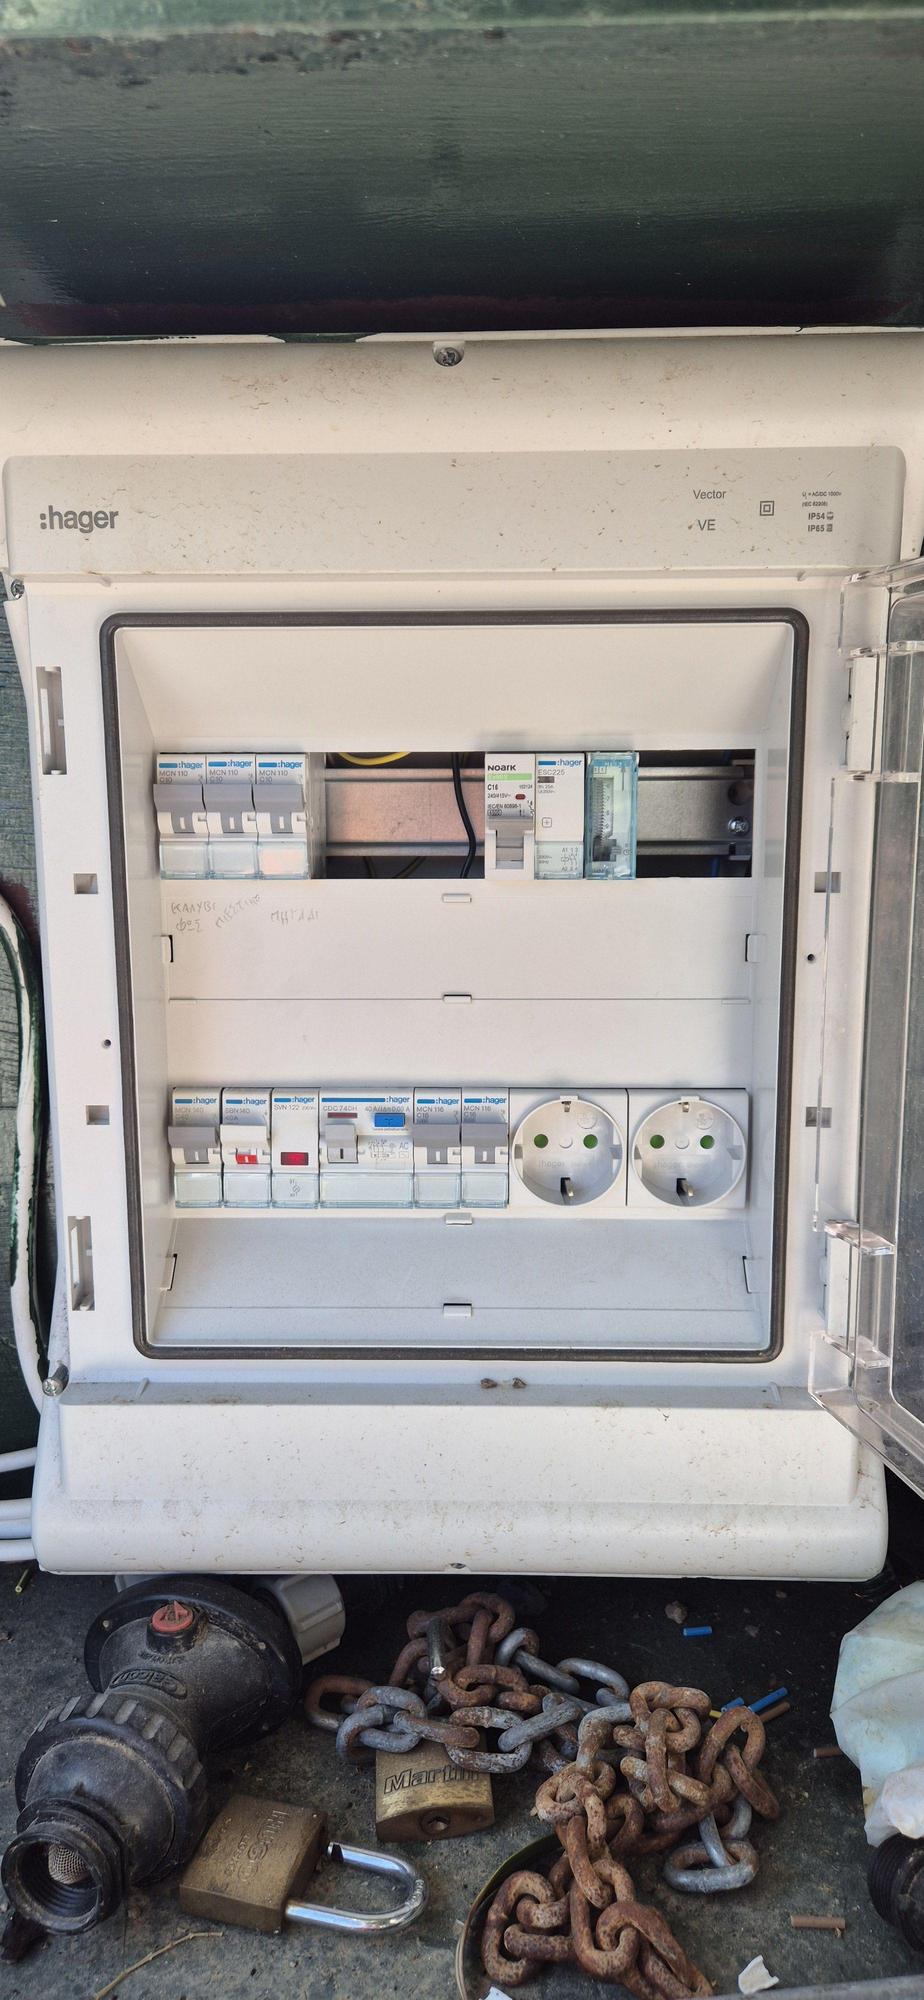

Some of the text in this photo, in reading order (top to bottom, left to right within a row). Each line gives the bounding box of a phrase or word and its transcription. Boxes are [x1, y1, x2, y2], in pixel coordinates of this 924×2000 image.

[693, 488, 727, 500] Vector
[808, 512, 825, 520] IP54
[698, 518, 716, 531] VE
[807, 524, 825, 532] IP65
